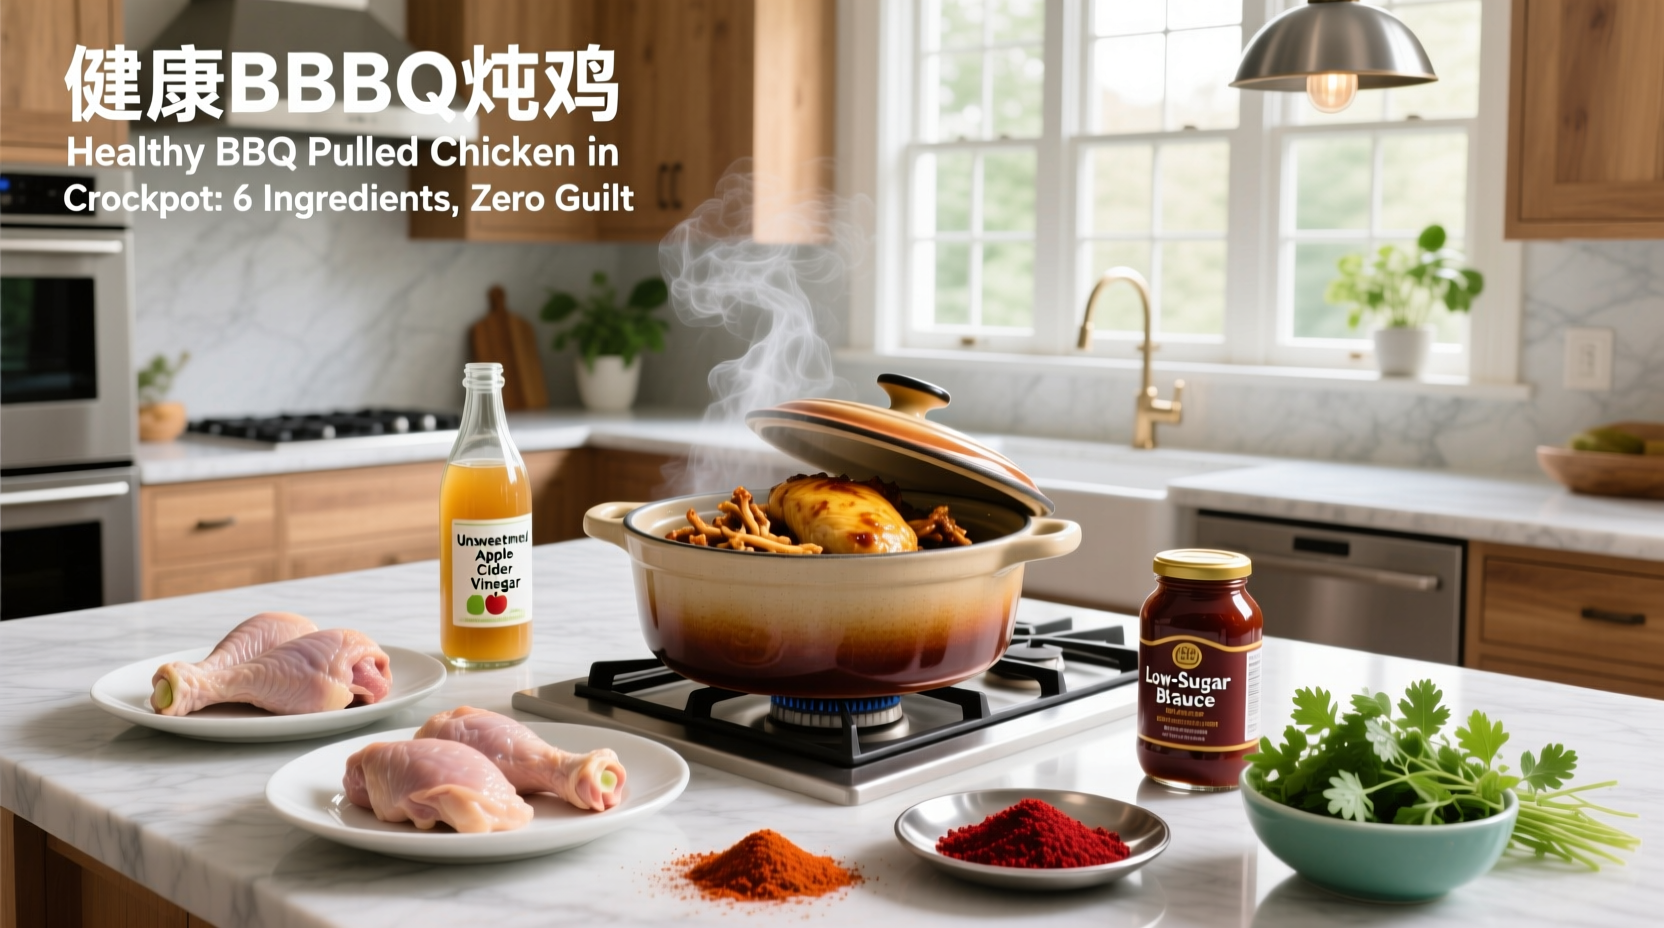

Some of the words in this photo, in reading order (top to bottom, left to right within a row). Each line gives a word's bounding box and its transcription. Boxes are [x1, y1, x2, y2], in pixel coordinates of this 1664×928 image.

[475, 547, 514, 563] Apple
[470, 577, 521, 593] Vinegar
[1145, 665, 1232, 694] Low-Sugar
